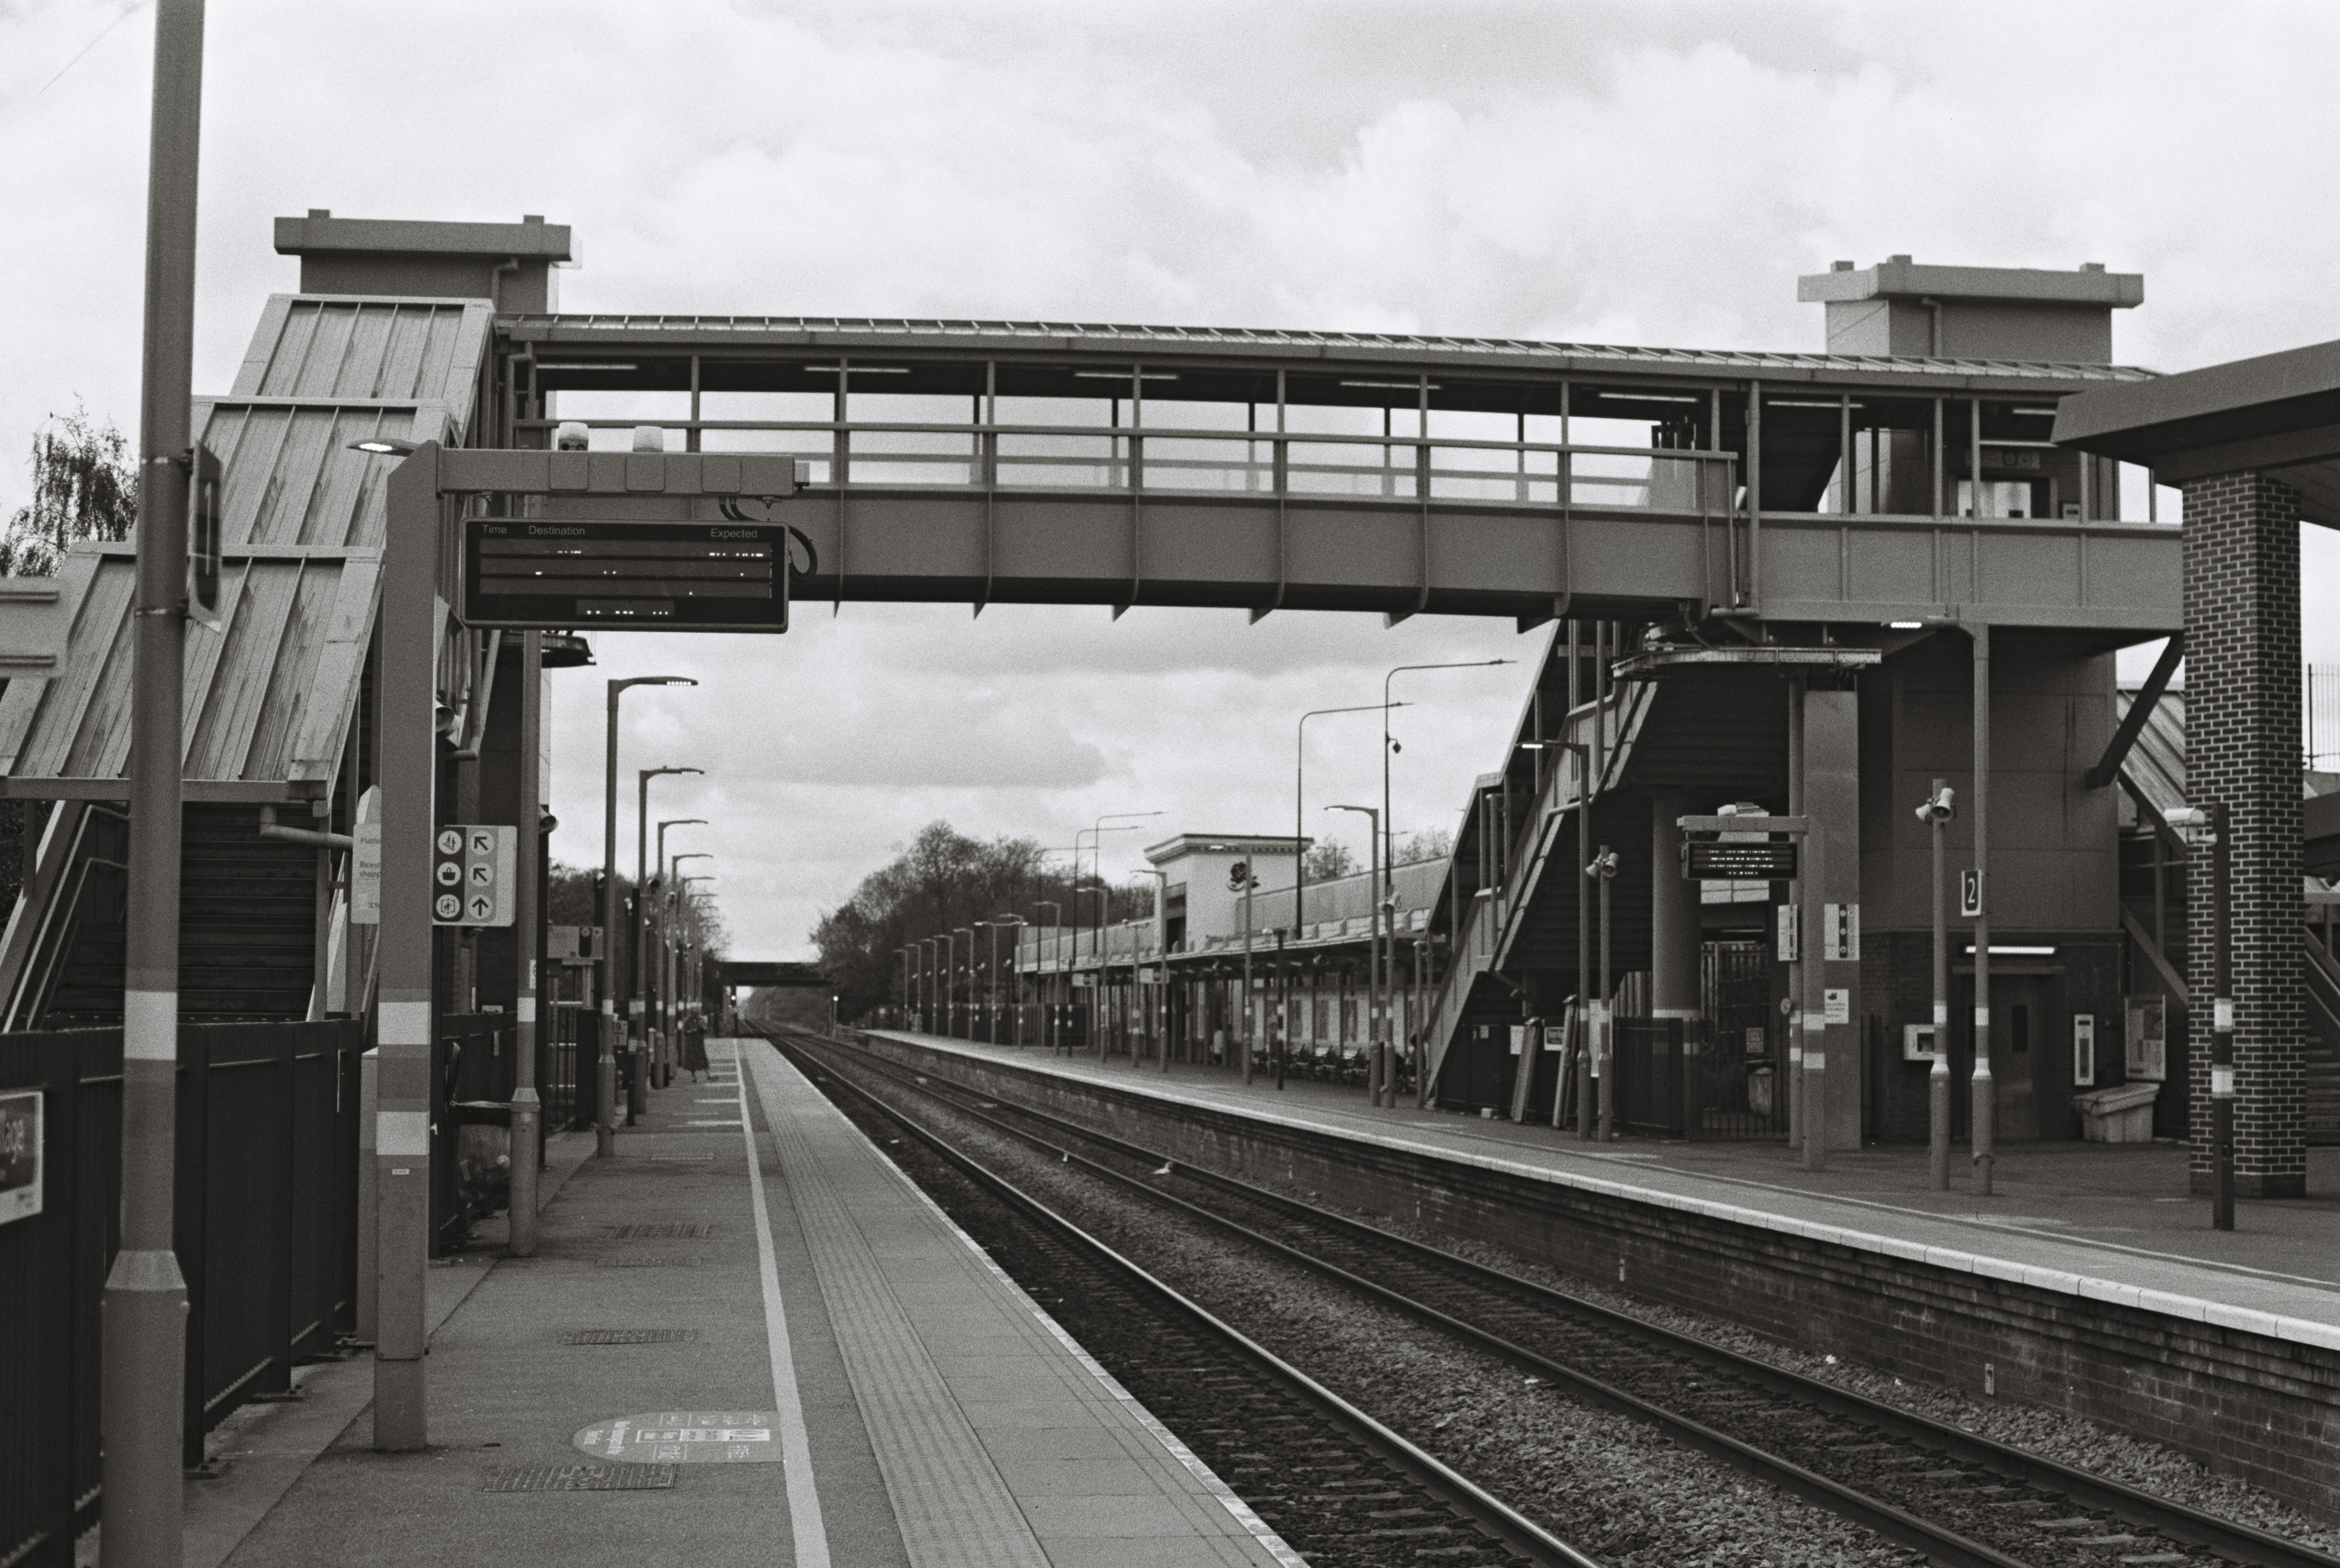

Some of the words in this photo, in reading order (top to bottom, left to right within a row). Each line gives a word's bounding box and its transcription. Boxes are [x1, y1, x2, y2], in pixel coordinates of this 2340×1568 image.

[482, 524, 507, 534] Time
[529, 525, 585, 535] Destination
[711, 528, 757, 539] Expected
[359, 870, 380, 879] shopp
[1968, 877, 1976, 903] 2
